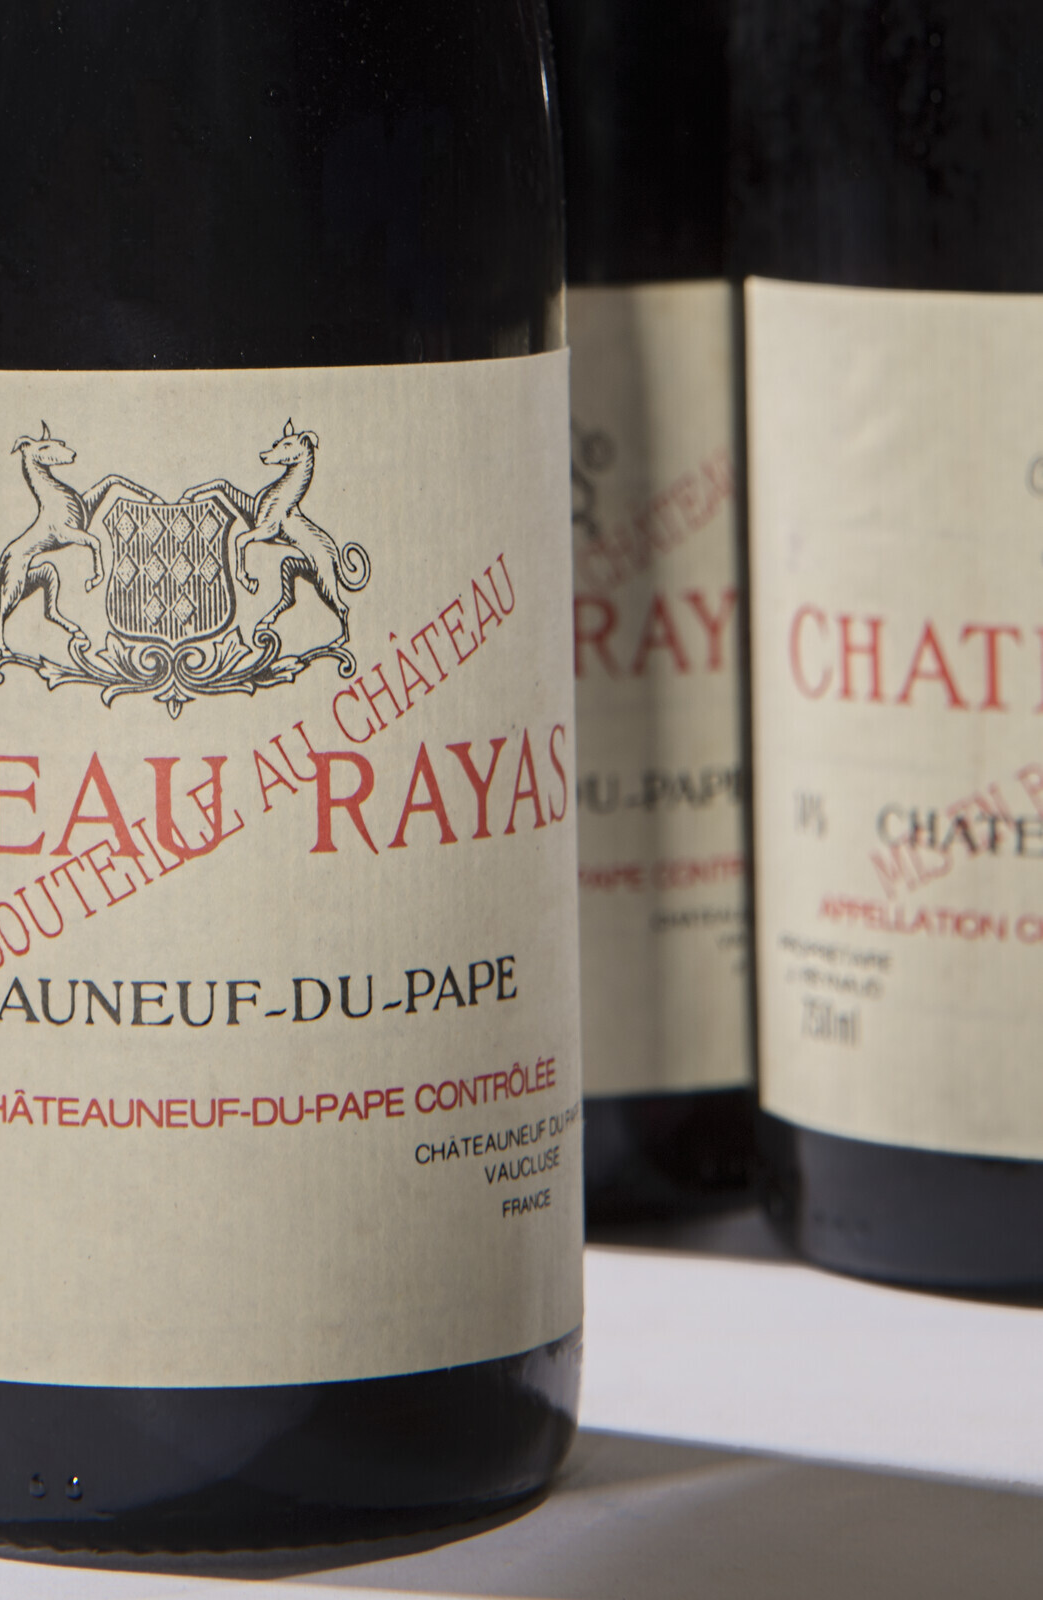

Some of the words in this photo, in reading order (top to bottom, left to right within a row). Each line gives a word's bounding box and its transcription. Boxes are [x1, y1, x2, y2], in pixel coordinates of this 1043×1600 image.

[574, 586, 739, 682] RAY
[787, 600, 1043, 715] CHAT
[252, 720, 319, 813] AU
[332, 552, 516, 744] CHÂTEAU
[306, 723, 568, 855] RAYAS
[414, 1055, 556, 1114] CONTRÔLÉE
[483, 1145, 561, 1186] VAUCLUSE
[501, 1187, 552, 1219] FRANCE
